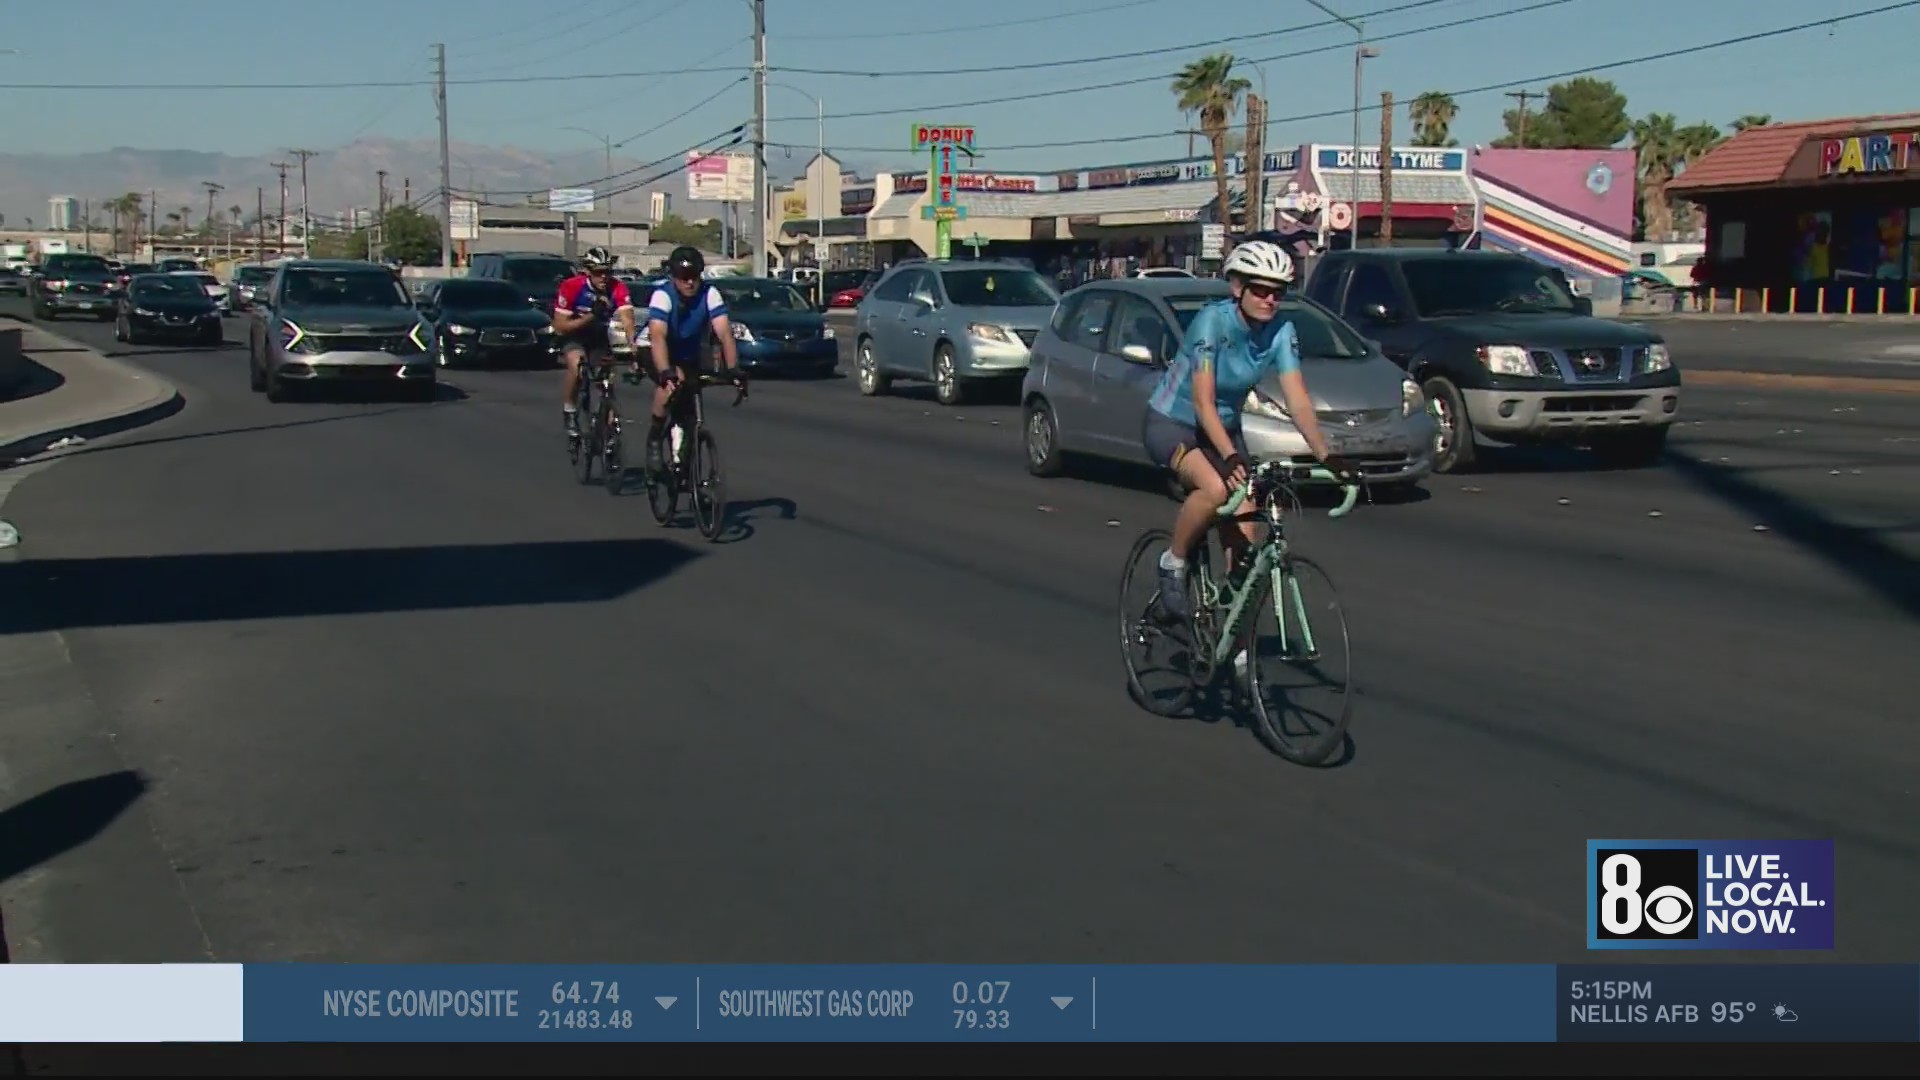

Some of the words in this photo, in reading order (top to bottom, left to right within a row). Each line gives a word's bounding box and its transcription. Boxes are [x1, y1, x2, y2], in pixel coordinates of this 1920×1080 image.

[918, 127, 974, 143] DONUT
[1337, 152, 1391, 168] DONU
[1399, 152, 1444, 169] TYME
